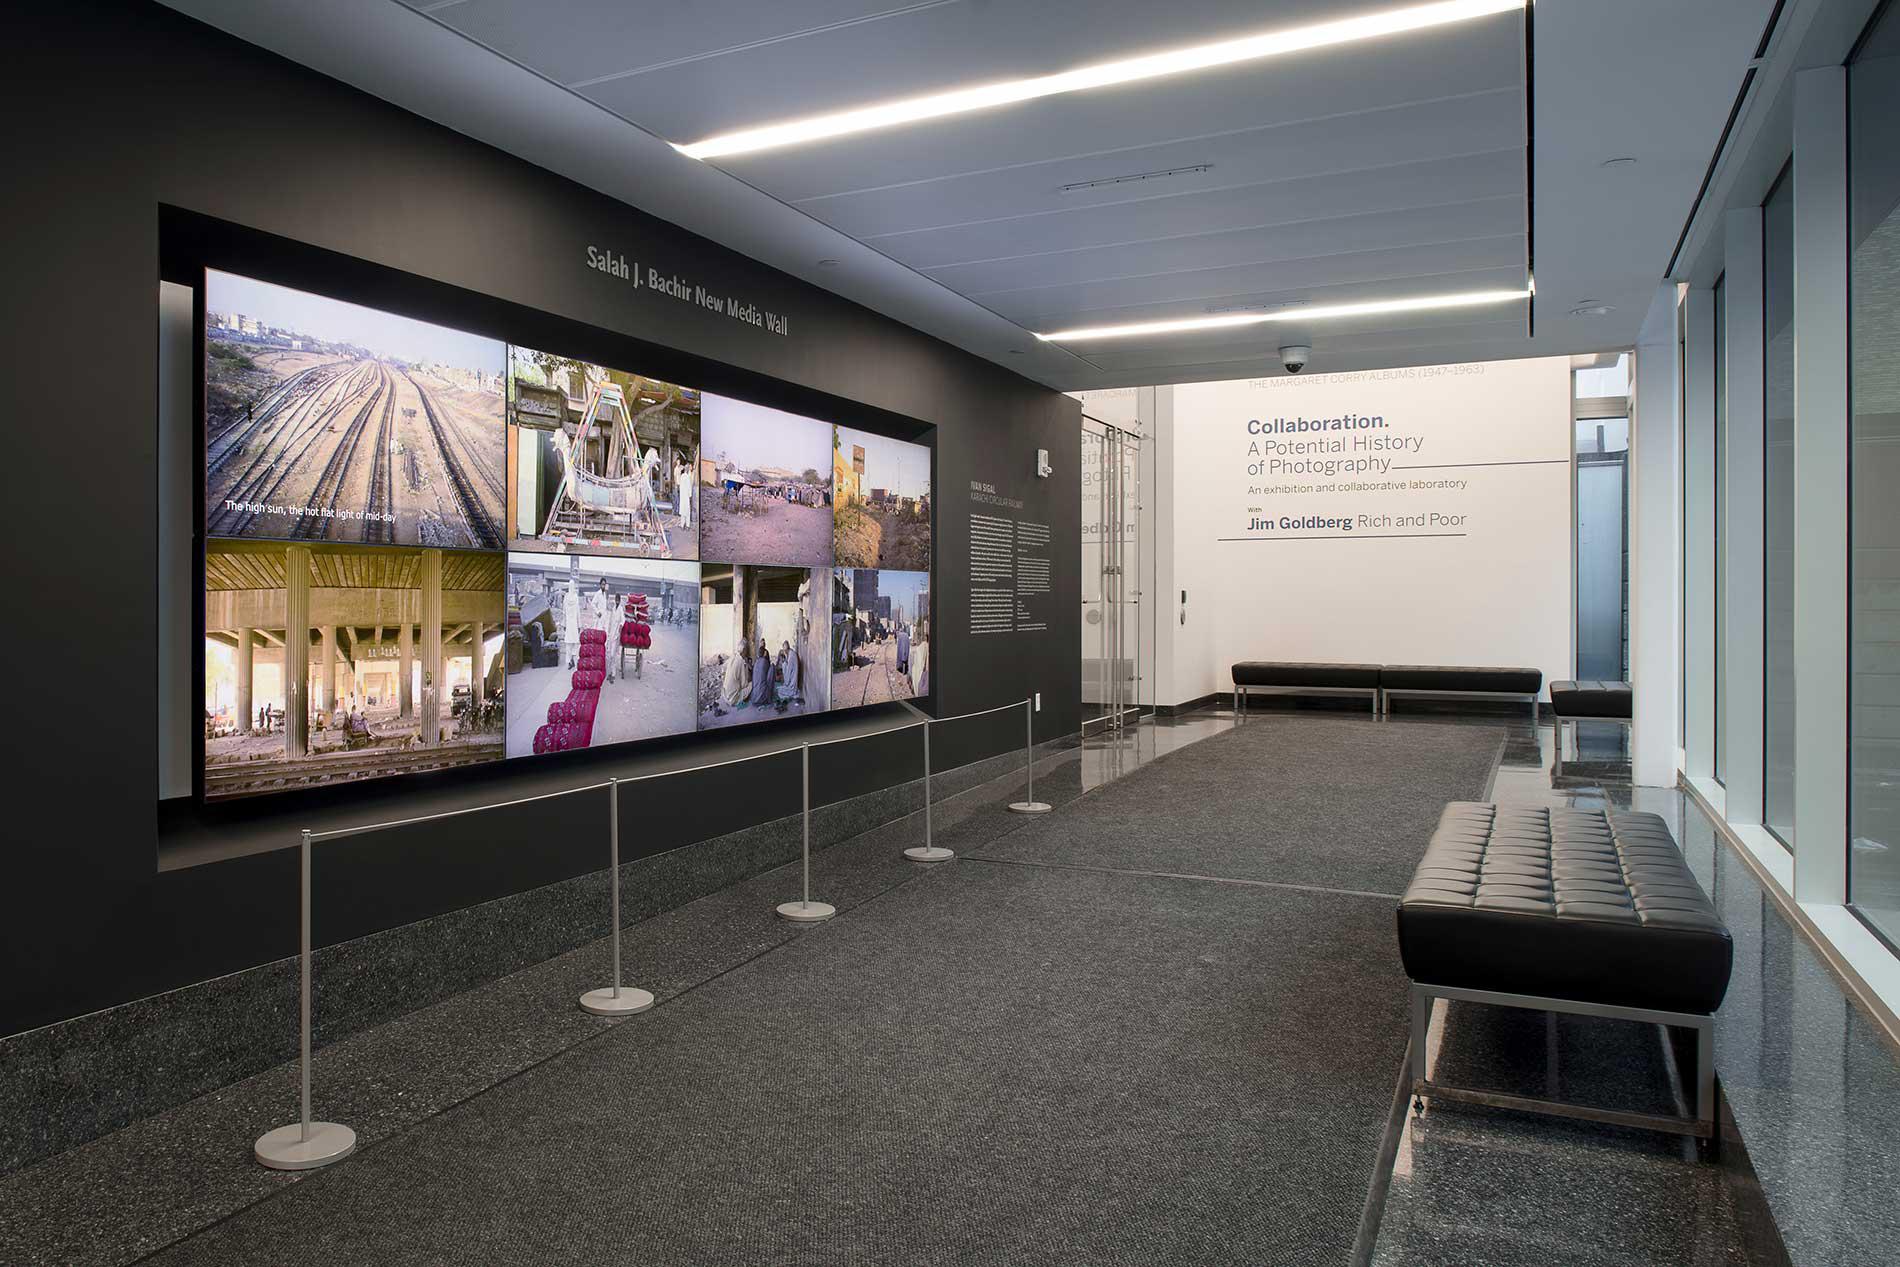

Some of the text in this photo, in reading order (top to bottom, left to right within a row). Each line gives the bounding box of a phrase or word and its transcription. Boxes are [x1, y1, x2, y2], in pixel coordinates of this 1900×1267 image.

[586, 245, 788, 336] Salah J. Bachir New Media Wall
[1248, 379, 1268, 389] THE
[1270, 374, 1328, 388] MARGARET
[1368, 368, 1416, 381] ALBUMS
[1247, 414, 1390, 435] Collaboration.
[1247, 434, 1424, 456] A Potential History
[1247, 455, 1391, 477] of Photography
[1247, 480, 1468, 495] An exhibition and collaborative laboratory
[225, 499, 397, 524] The high sun, the hot flat light of mid-day
[1247, 512, 1468, 531] Jim Goldberg Rich and Poor
